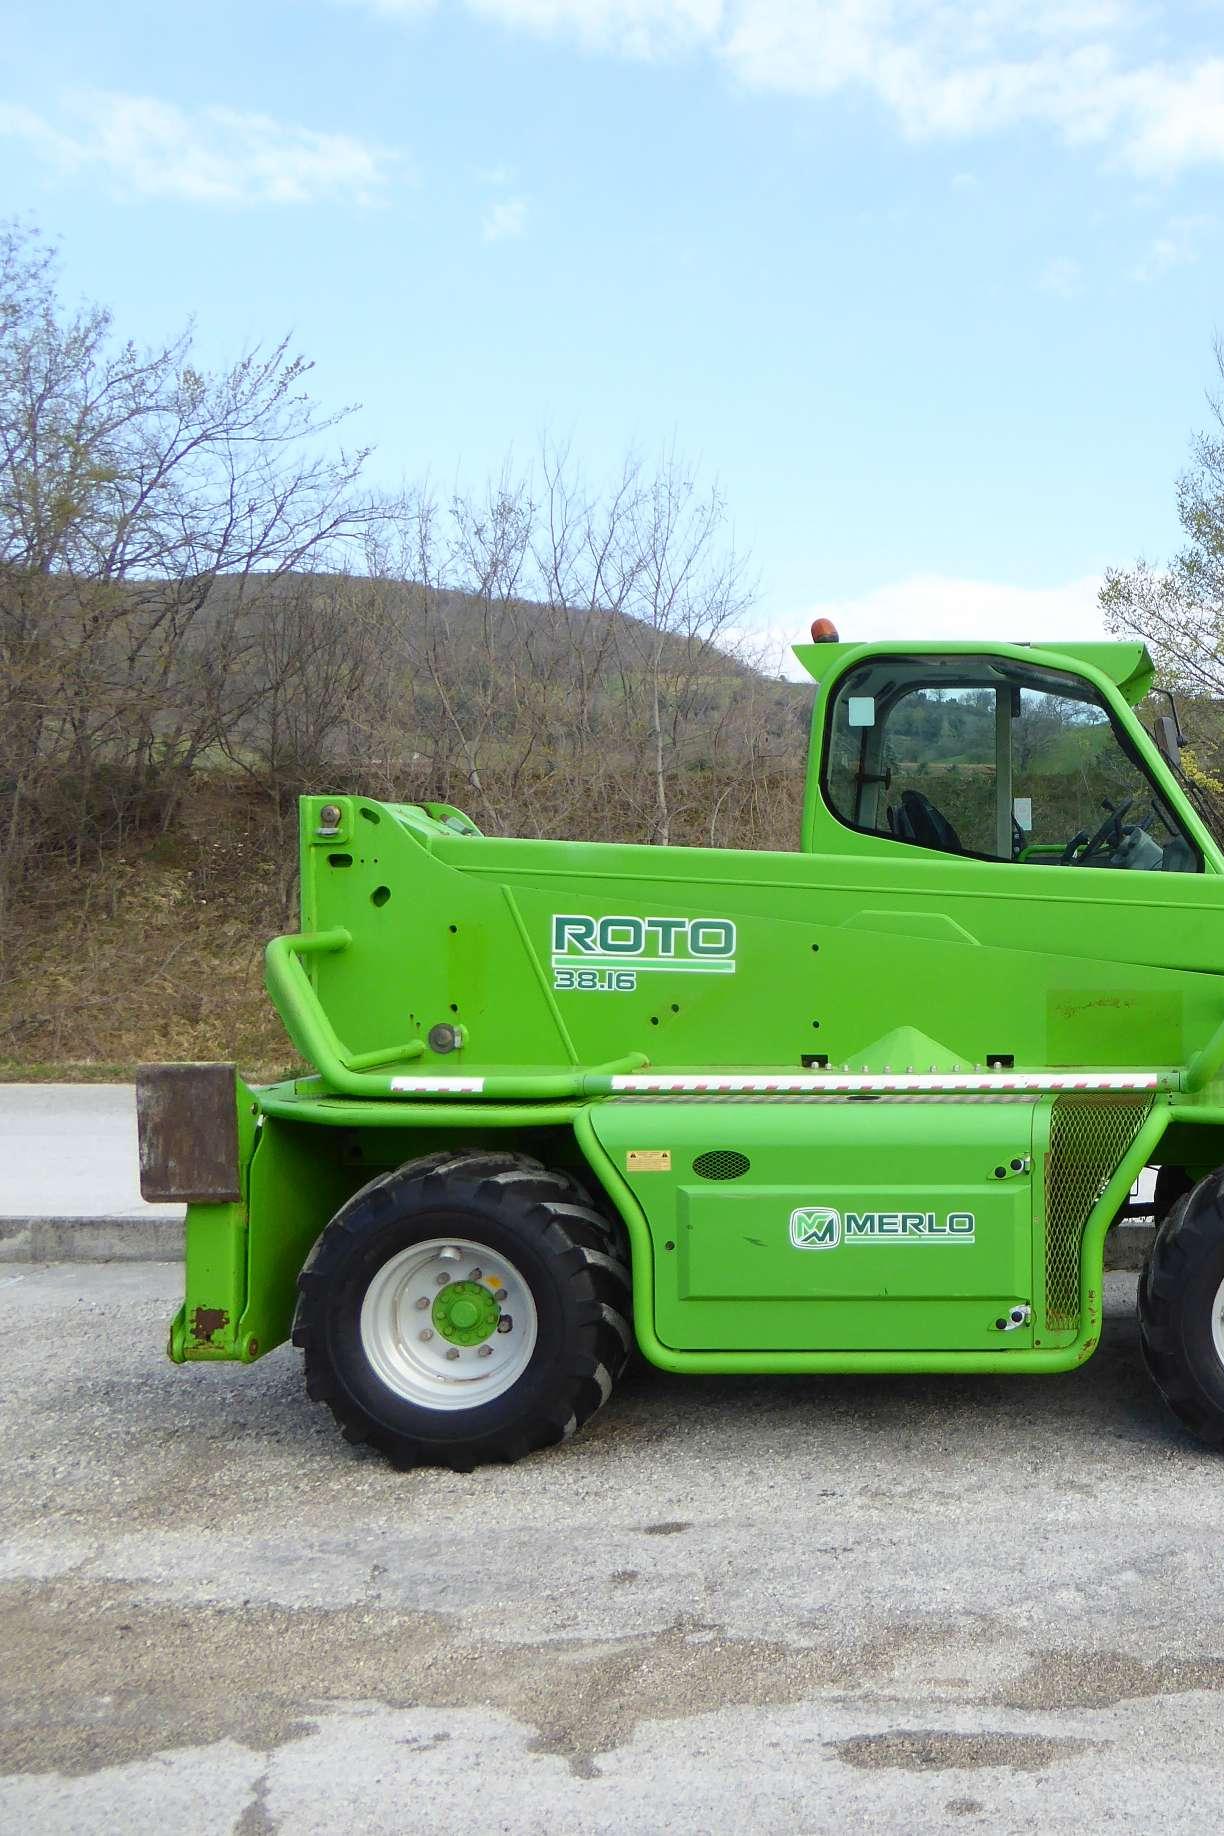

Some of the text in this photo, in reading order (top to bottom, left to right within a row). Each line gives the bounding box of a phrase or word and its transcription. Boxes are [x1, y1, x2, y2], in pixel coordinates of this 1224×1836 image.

[552, 915, 736, 957] ROTO
[554, 969, 637, 992] 38.16
[844, 1212, 976, 1235] MERLO
